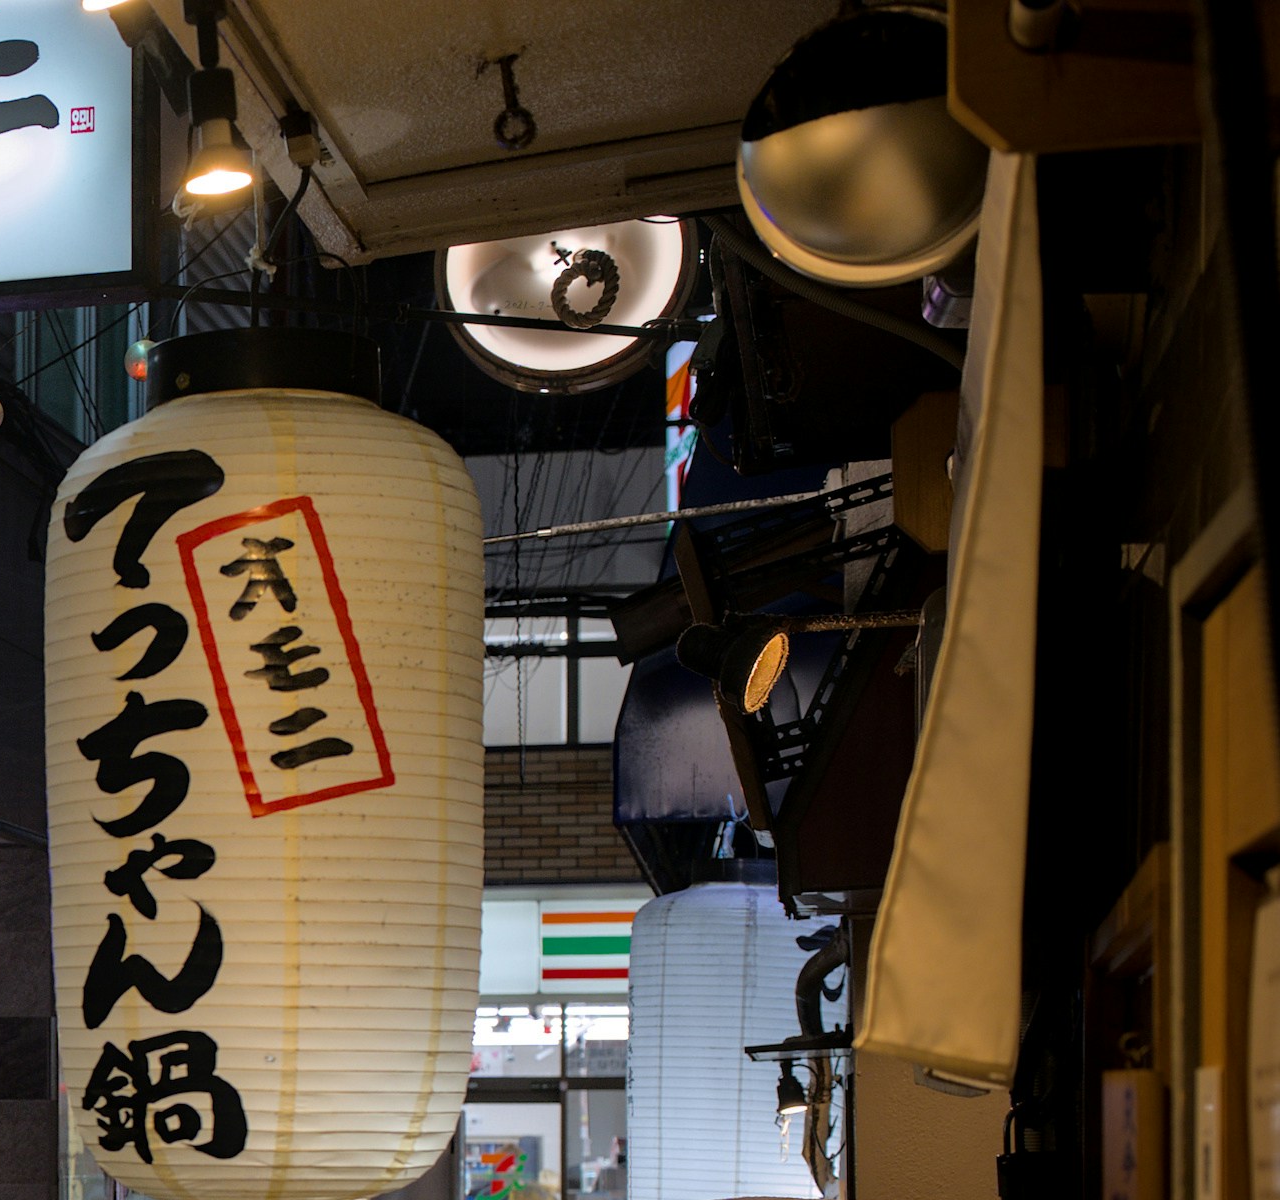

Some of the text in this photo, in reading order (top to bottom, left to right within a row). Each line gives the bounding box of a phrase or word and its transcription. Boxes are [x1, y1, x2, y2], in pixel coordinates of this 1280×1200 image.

[64, 449, 247, 1163] てっちゃん鍋
[220, 537, 353, 769] オモニ
